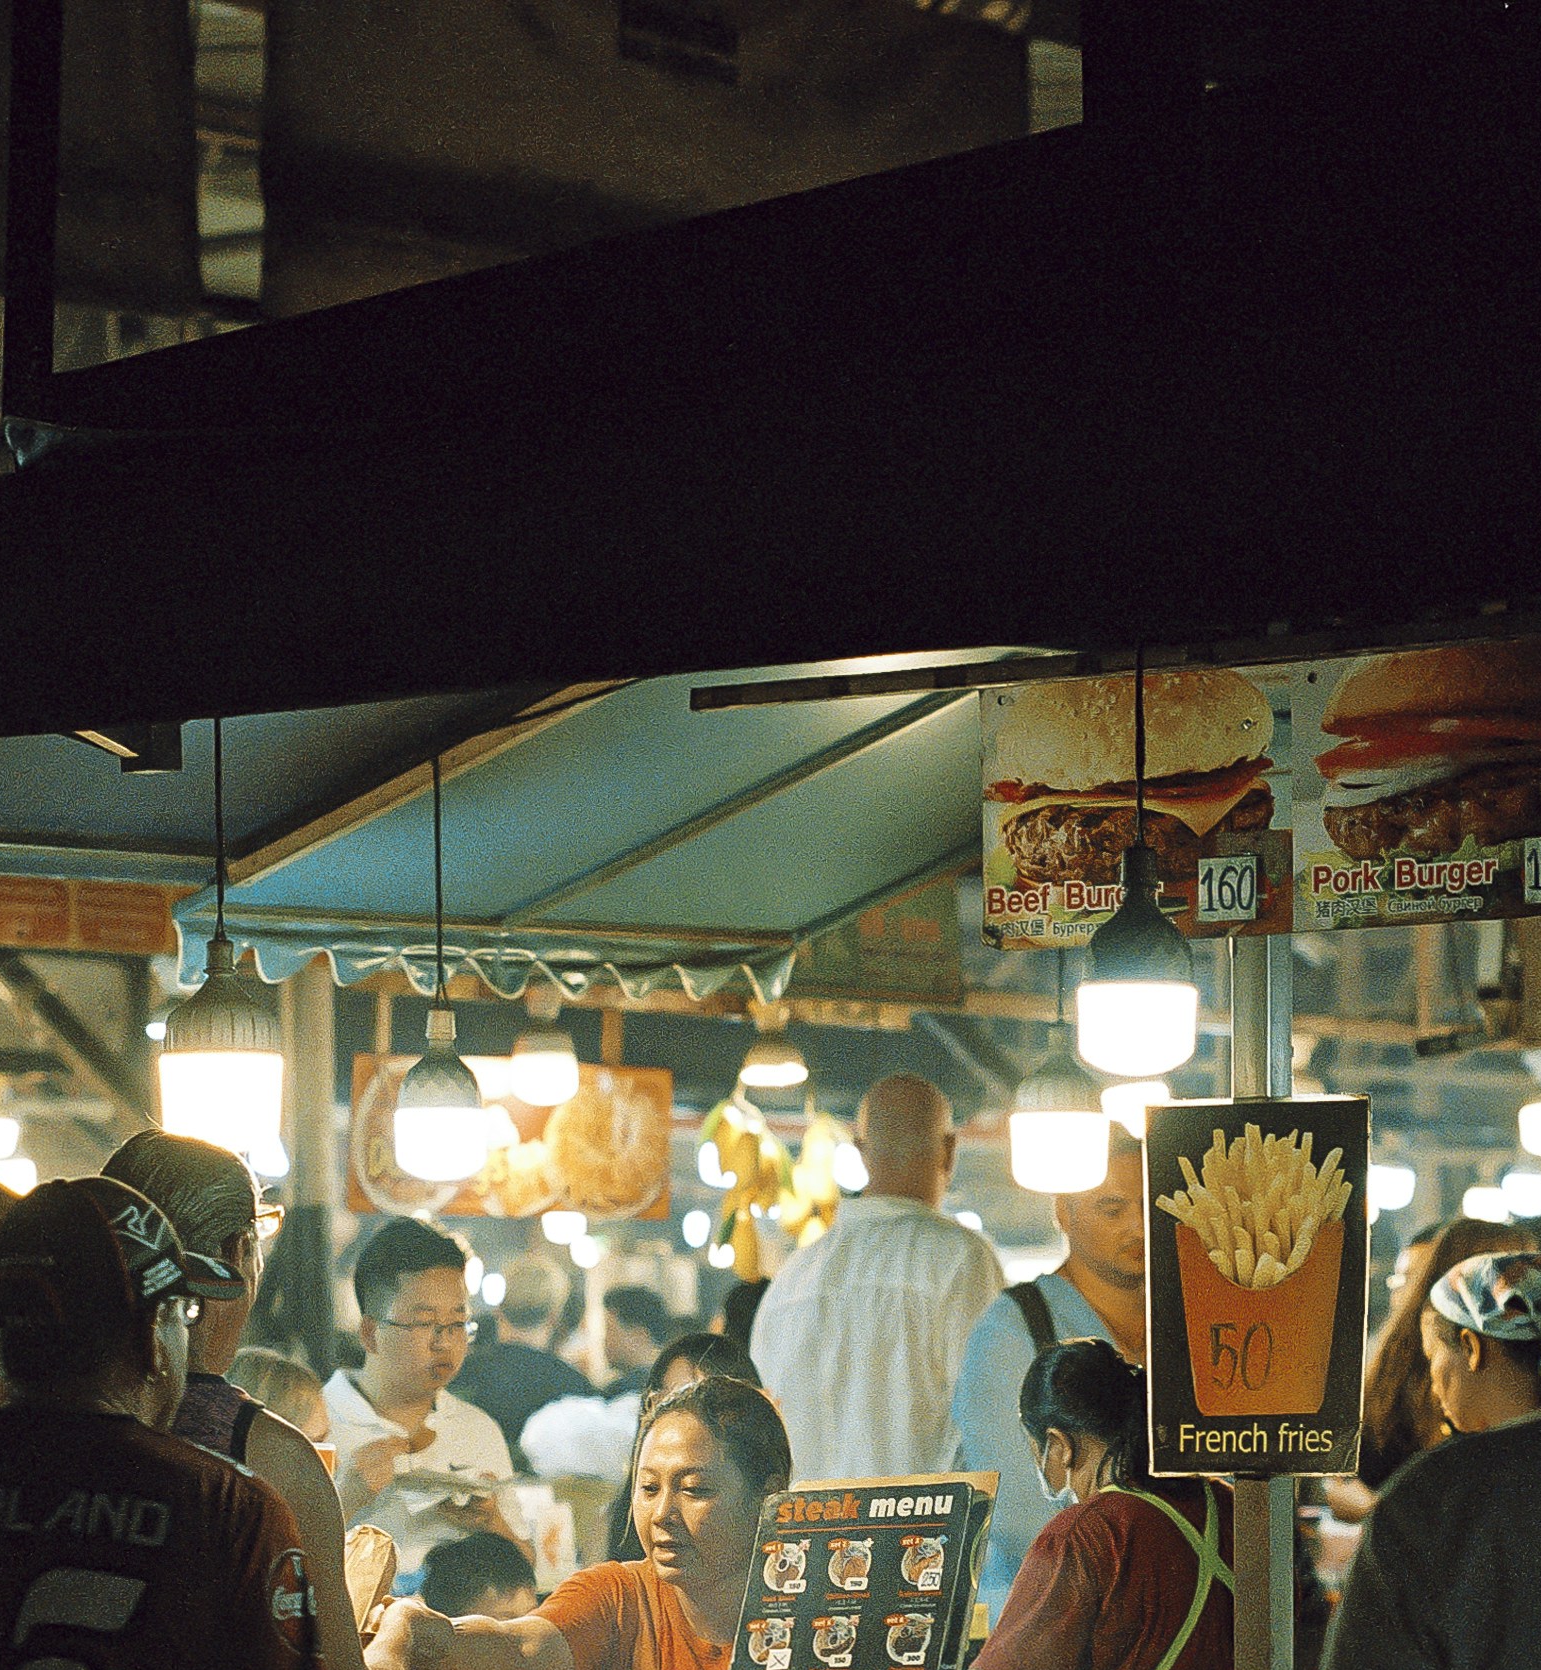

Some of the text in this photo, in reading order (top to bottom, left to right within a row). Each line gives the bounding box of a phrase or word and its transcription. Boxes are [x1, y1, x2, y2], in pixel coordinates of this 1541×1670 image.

[1200, 865, 1255, 912] 160
[1312, 857, 1497, 895] Pork Burger
[986, 885, 1051, 915] Beef
[1053, 922, 1095, 937] Бургер
[1210, 1321, 1273, 1391] 50
[1178, 1421, 1334, 1453] French fries
[775, 1492, 954, 1524] steak menu
